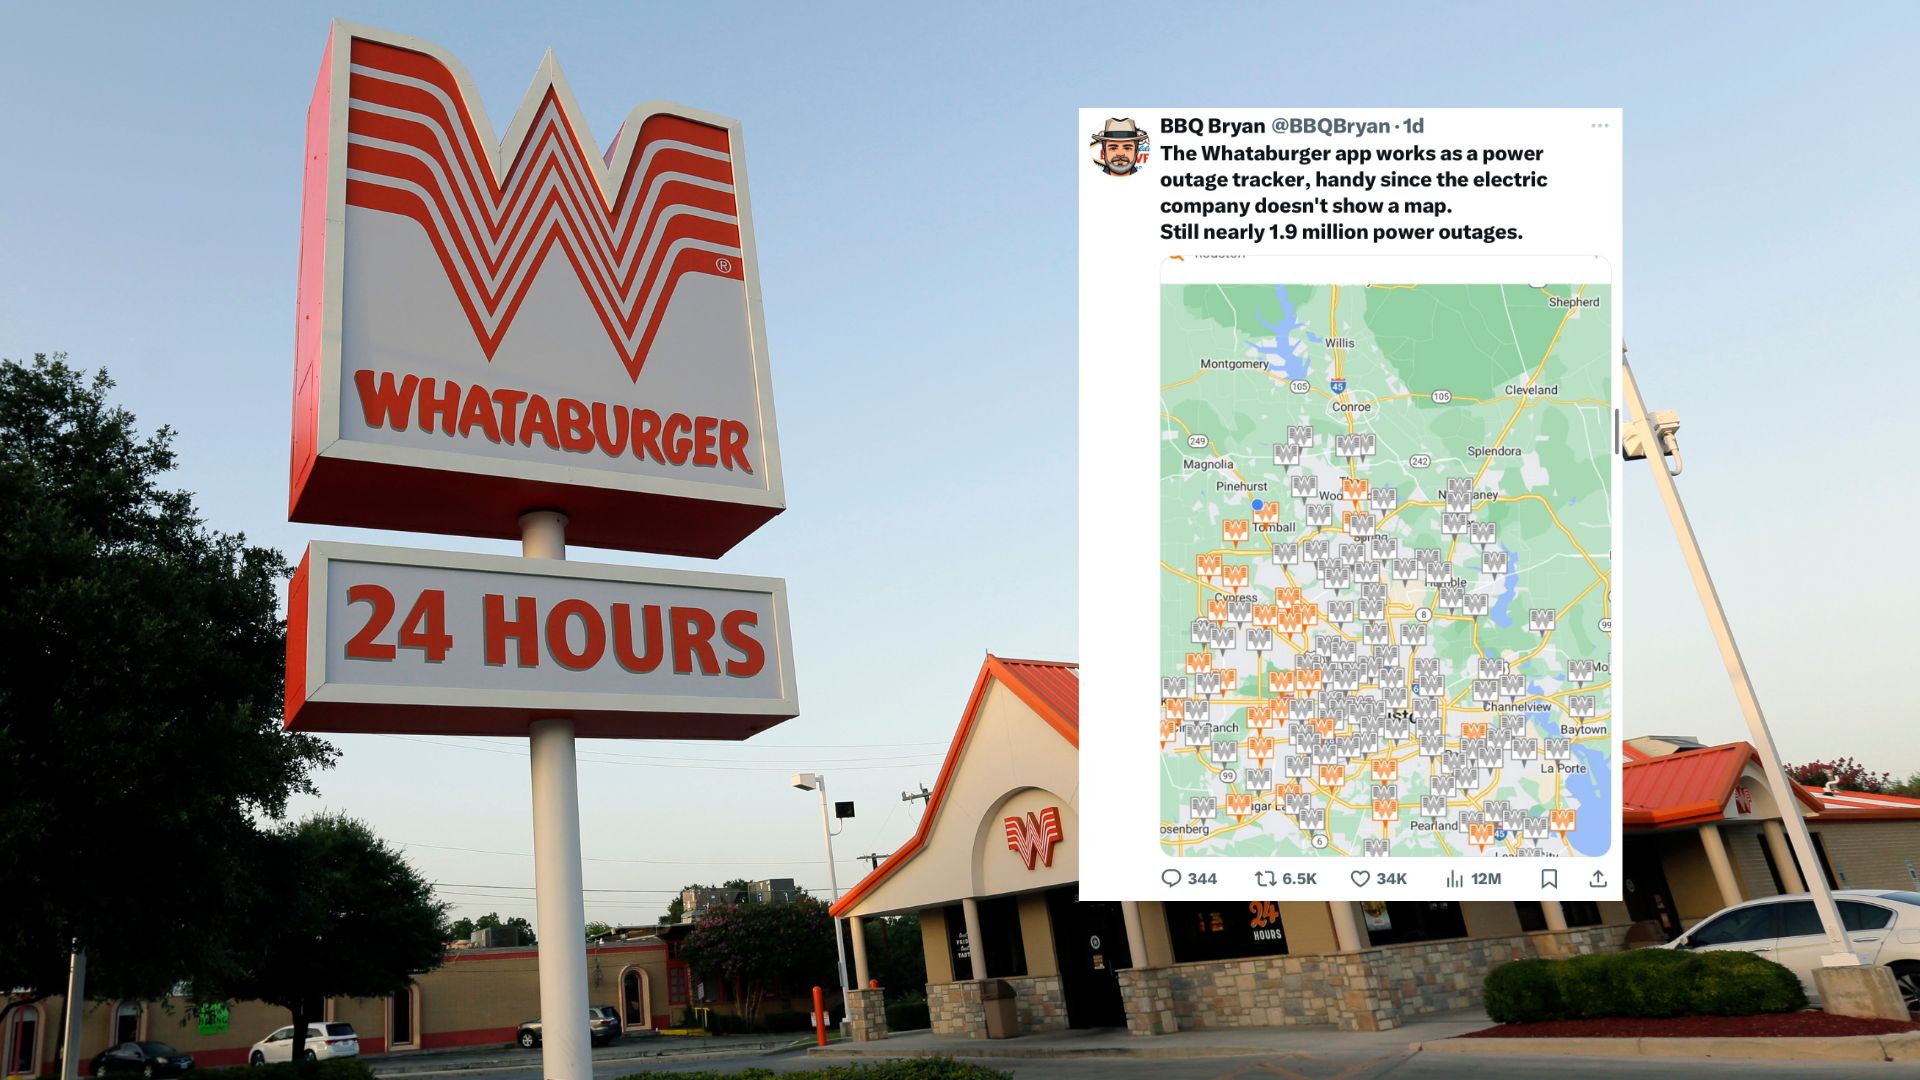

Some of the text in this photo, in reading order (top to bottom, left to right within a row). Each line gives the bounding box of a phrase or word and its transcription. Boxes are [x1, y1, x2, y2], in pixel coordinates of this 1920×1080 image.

[354, 369, 754, 475] WHATABURGER
[343, 584, 766, 678] 24 HOURS
[1248, 901, 1279, 928] 24
[1253, 929, 1282, 941] HOURS
